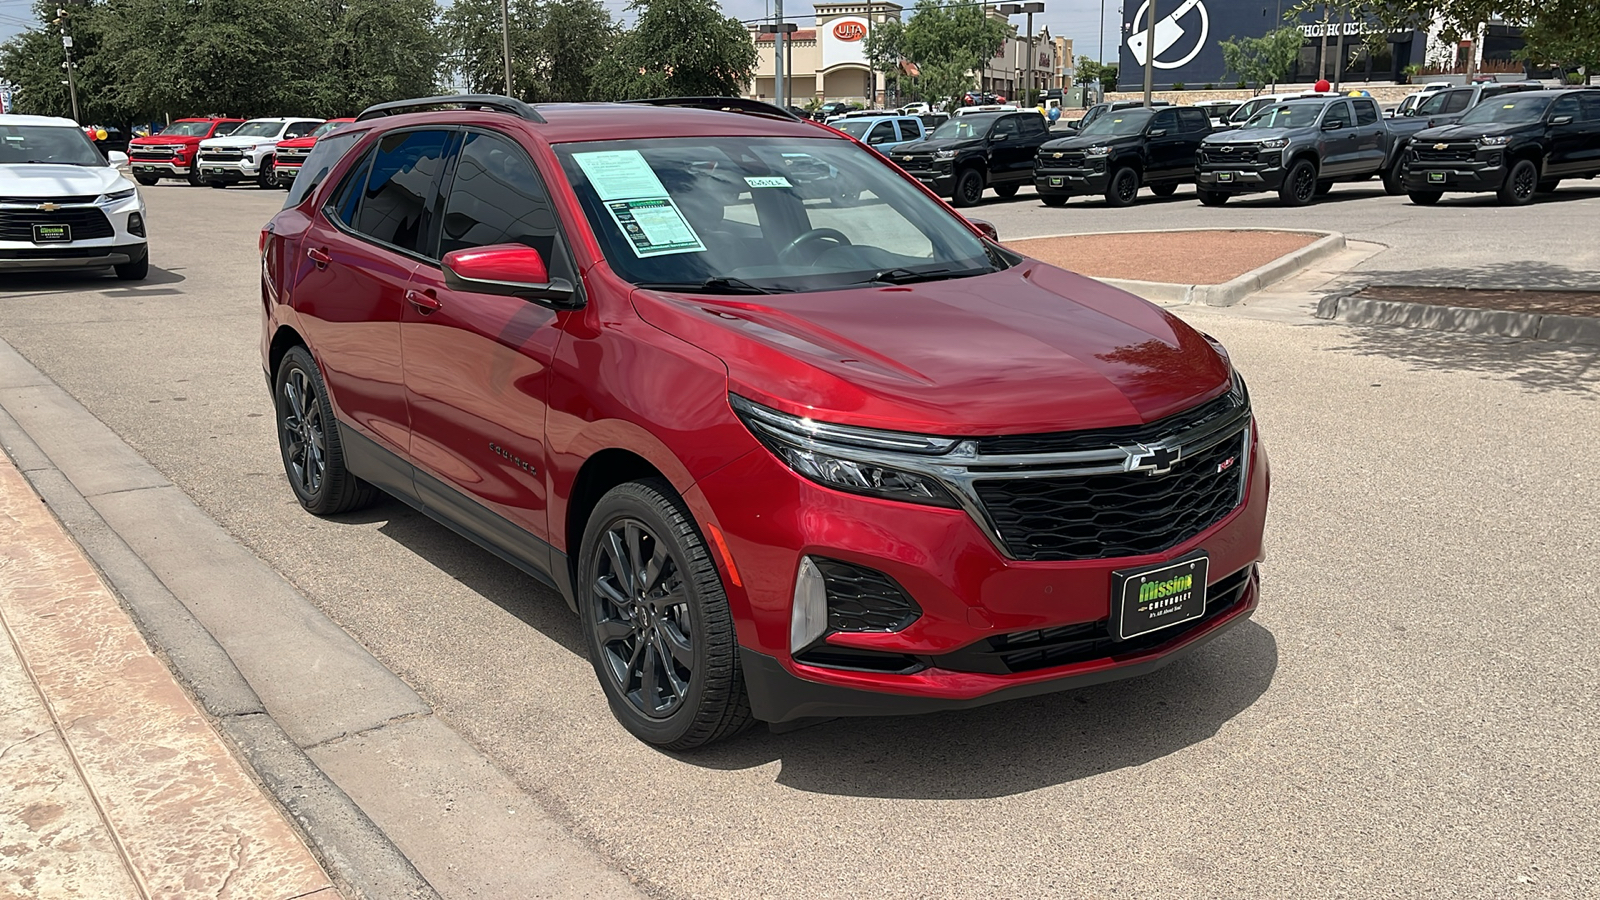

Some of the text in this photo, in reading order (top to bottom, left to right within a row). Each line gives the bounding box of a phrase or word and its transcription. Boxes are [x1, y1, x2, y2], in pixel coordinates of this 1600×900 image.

[839, 24, 864, 36] ULTA
[489, 442, 537, 476] EQUINOX
[1217, 456, 1234, 473] RS
[1139, 573, 1193, 603] Mission
[1148, 591, 1192, 611] CHEVROLET
